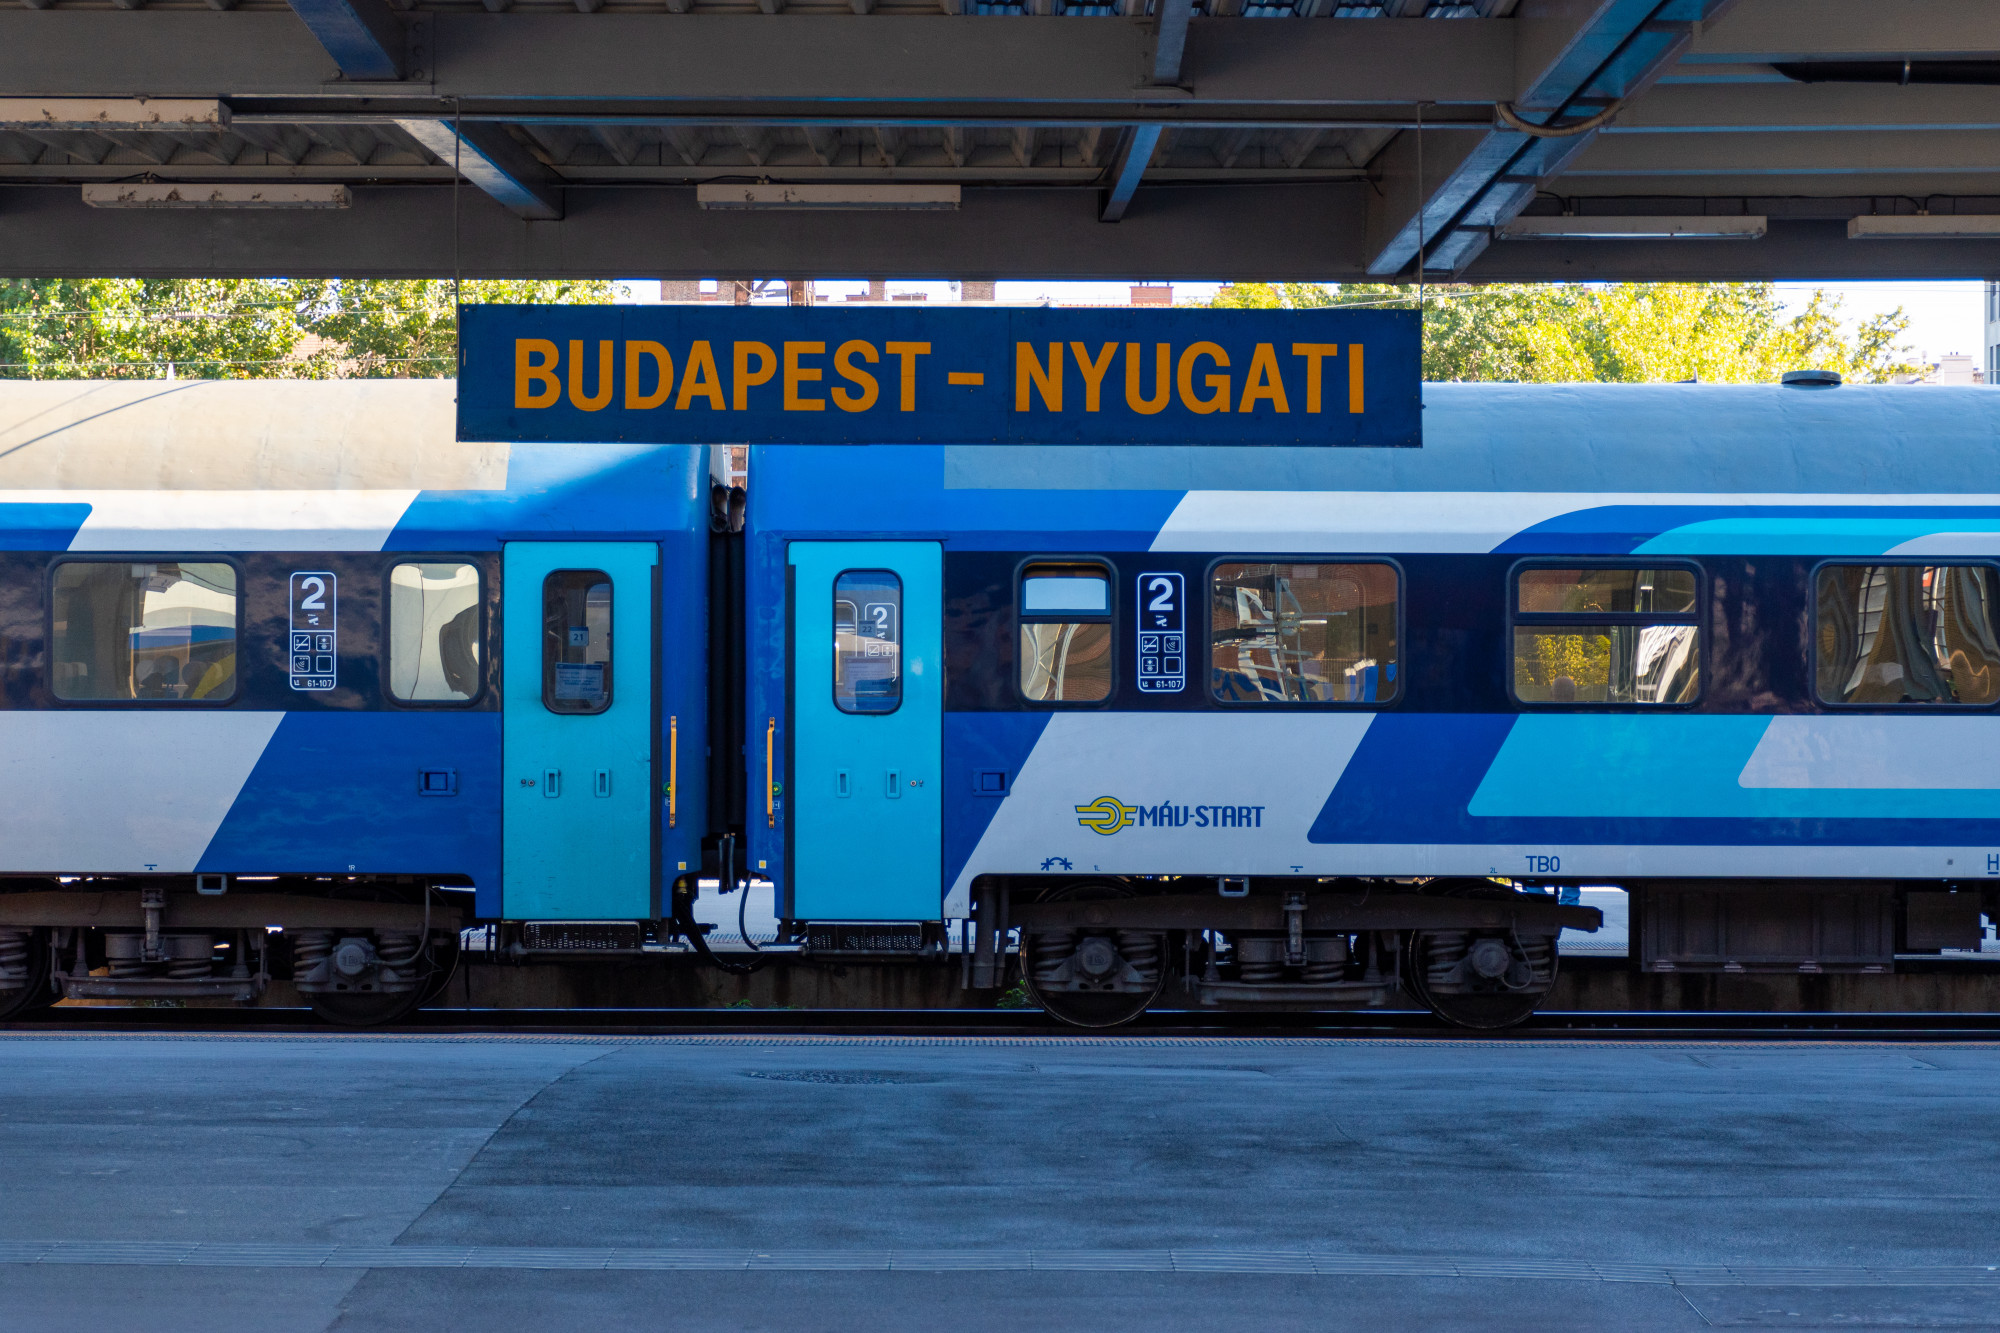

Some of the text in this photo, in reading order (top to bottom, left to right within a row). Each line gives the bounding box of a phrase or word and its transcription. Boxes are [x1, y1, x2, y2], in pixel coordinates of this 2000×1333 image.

[513, 338, 932, 413] BUDAPEST
[1014, 340, 1366, 415] NYUGATI
[301, 576, 325, 609] 2
[1148, 577, 1174, 611] 2
[573, 633, 584, 641] 21
[307, 679, 332, 687] 61-107
[1156, 680, 1181, 688] 61-107
[1139, 802, 1265, 826] MÁV-START
